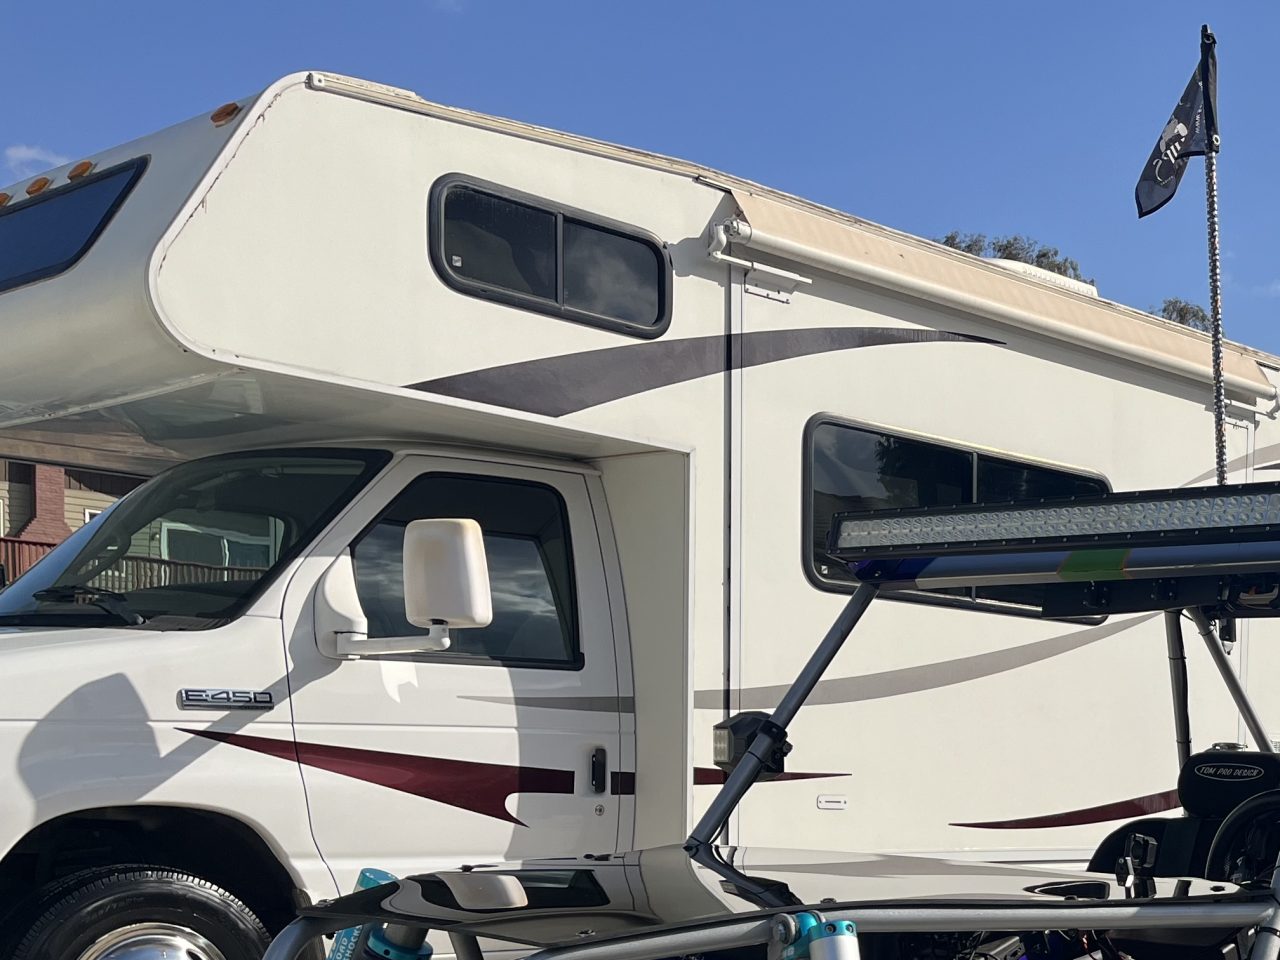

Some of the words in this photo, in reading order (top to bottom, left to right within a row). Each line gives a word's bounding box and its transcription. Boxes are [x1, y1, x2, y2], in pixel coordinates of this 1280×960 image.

[182, 689, 273, 703] E-450
[1200, 765, 1216, 775] TOM
[1217, 766, 1232, 776] PRO
[1233, 768, 1260, 777] DESIGN
